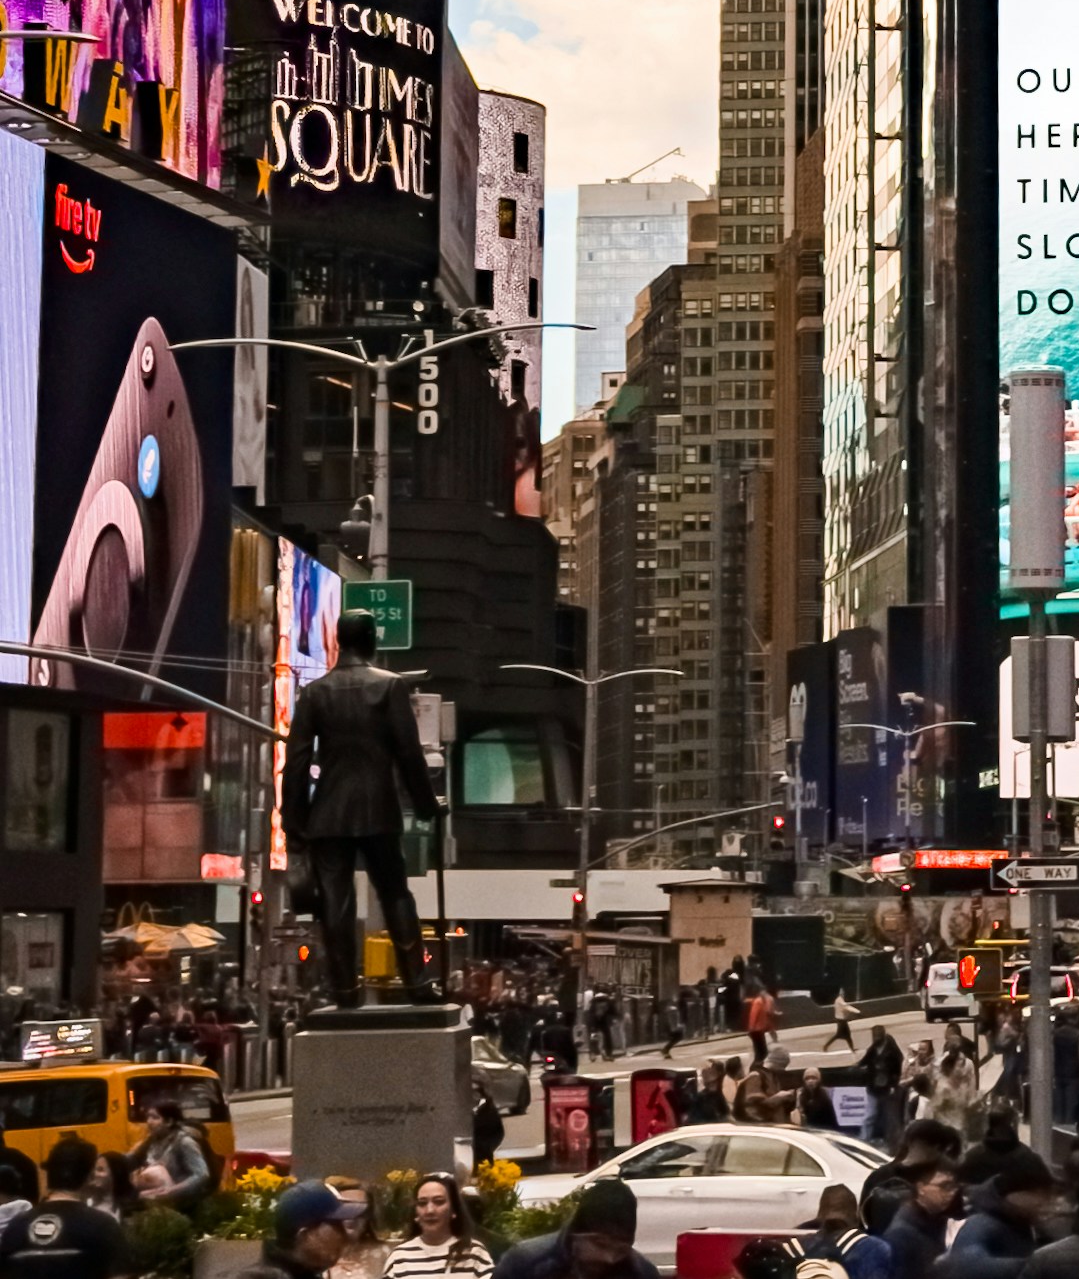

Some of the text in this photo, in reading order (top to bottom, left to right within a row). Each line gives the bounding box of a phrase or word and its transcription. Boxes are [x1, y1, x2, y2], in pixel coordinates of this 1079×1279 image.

[416, 23, 435, 55] TO
[357, 61, 434, 128] TIMES
[271, 99, 434, 200] SQUARE
[55, 183, 102, 242] fire tv
[418, 329, 439, 435] 1500
[370, 589, 387, 602] TO
[1006, 867, 1072, 879] ONE WAY
